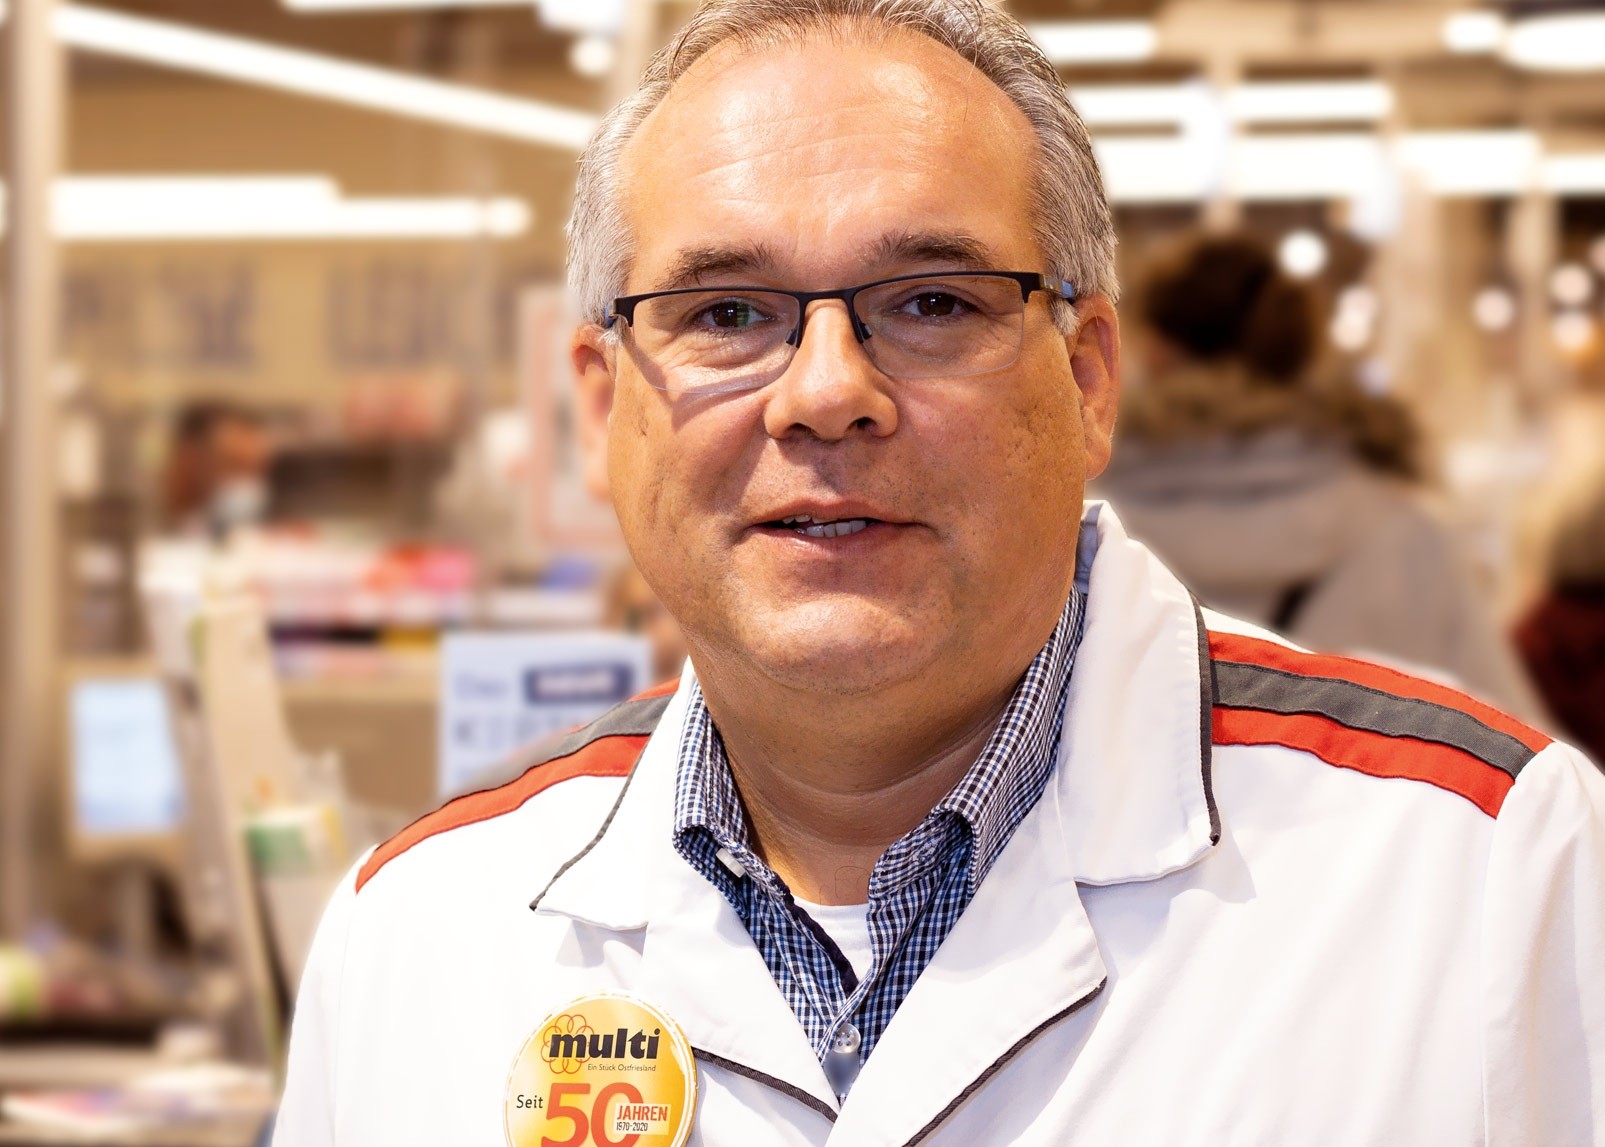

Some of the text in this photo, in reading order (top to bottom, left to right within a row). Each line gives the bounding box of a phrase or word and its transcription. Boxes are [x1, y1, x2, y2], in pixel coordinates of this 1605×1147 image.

[549, 1028, 661, 1059] multi
[587, 1063, 597, 1071] Ein
[617, 1063, 656, 1072] Ostfriesland
[516, 1082, 644, 1147] Seit 50
[616, 1105, 668, 1122] JAHREN
